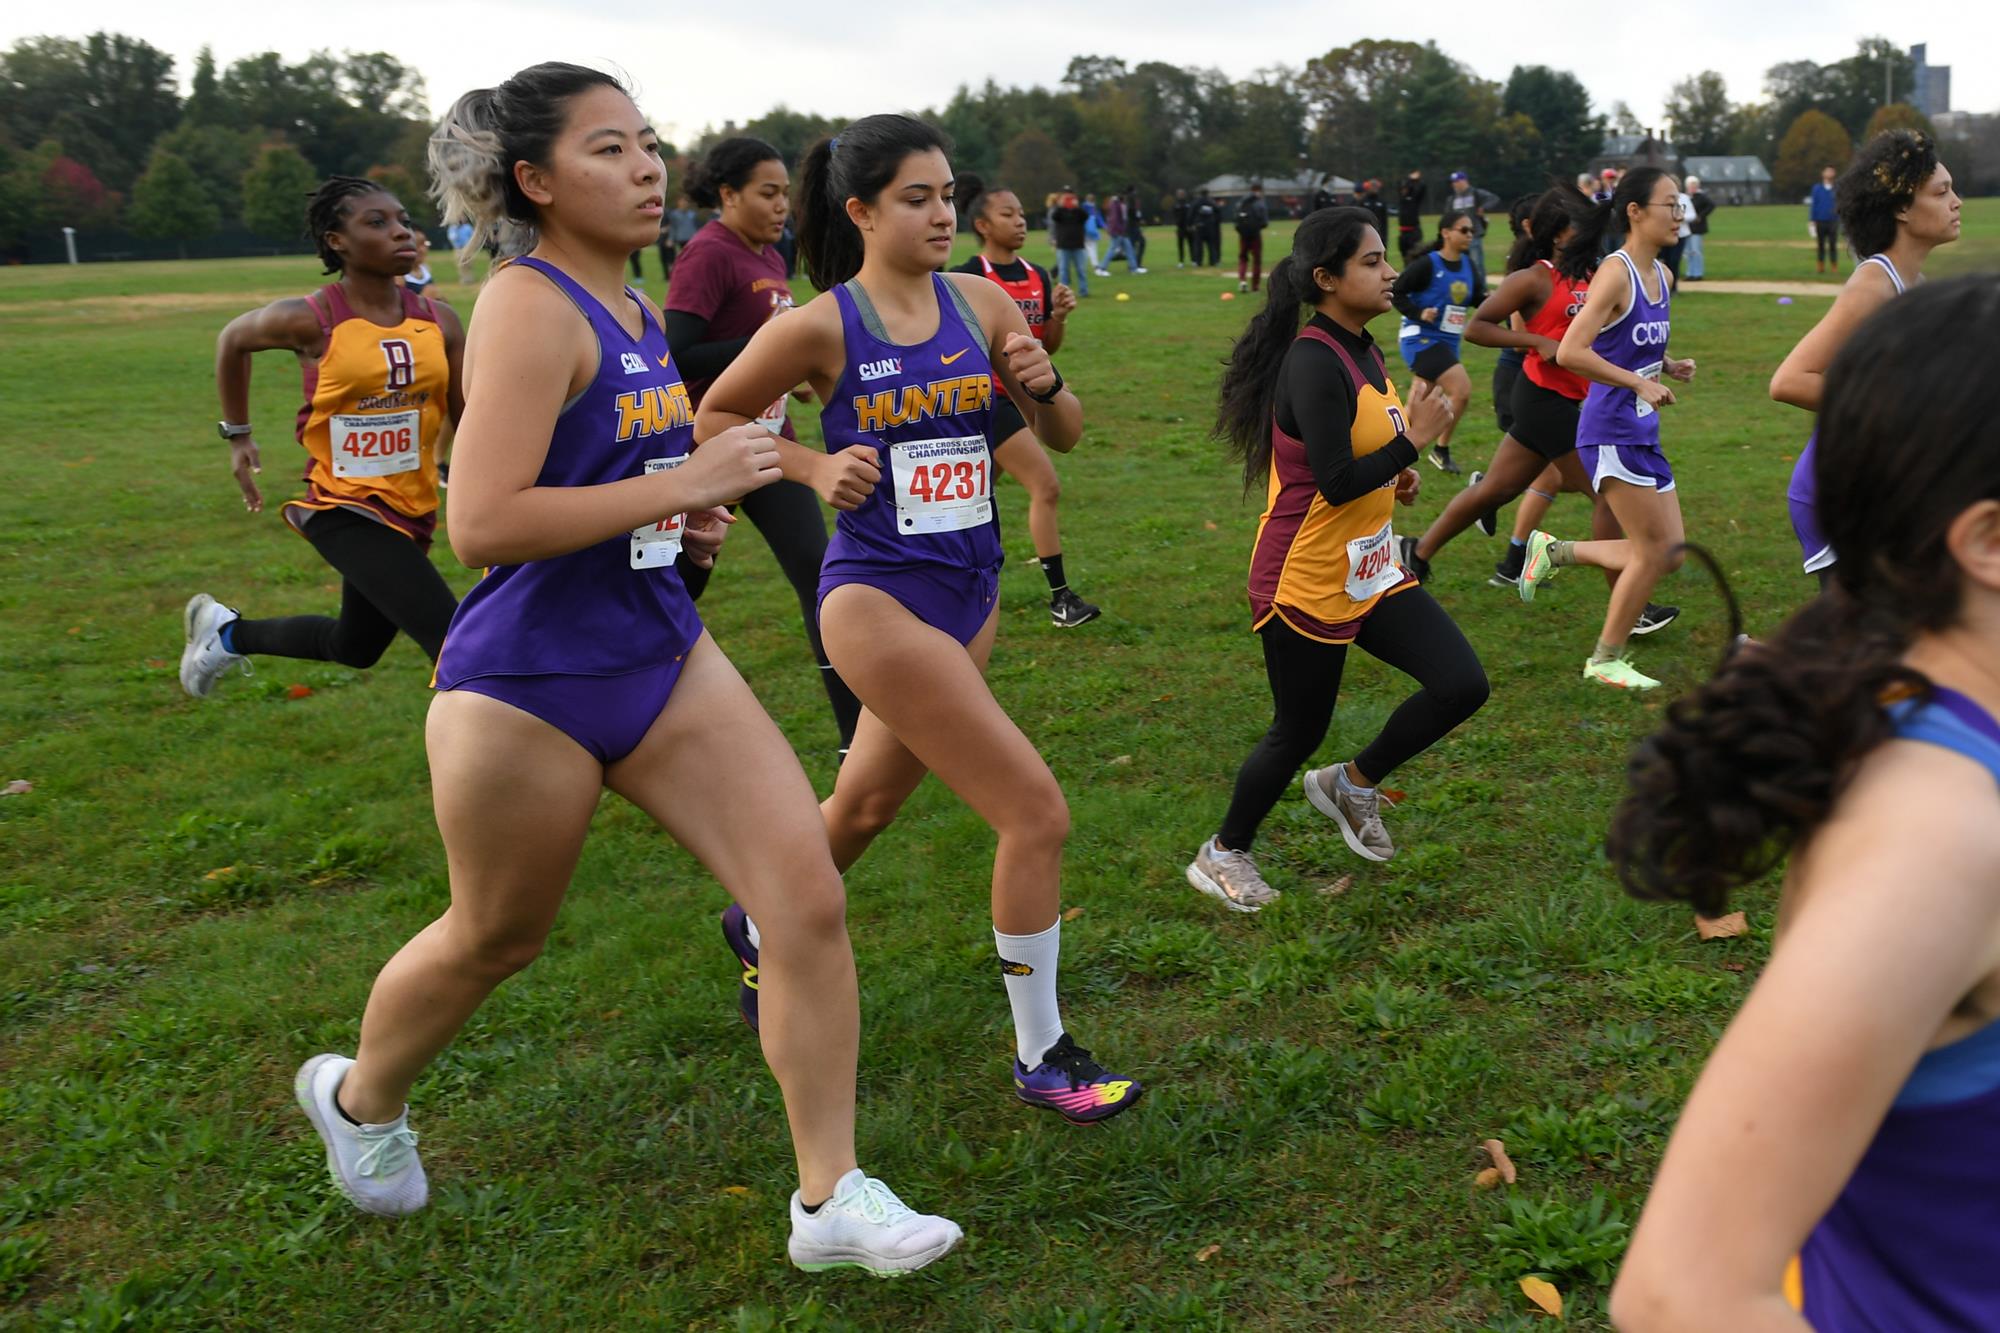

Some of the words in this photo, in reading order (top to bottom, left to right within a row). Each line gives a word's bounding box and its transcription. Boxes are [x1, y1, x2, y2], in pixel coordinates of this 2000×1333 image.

[858, 358, 903, 381] CUNY
[615, 381, 695, 442] HUNTE
[853, 373, 992, 433] HUNTER
[342, 426, 411, 458] 4206
[902, 443, 934, 452] CUNYAC
[936, 440, 961, 448] CROSS
[909, 458, 986, 504] 4231
[1355, 540, 1391, 581] 4204
